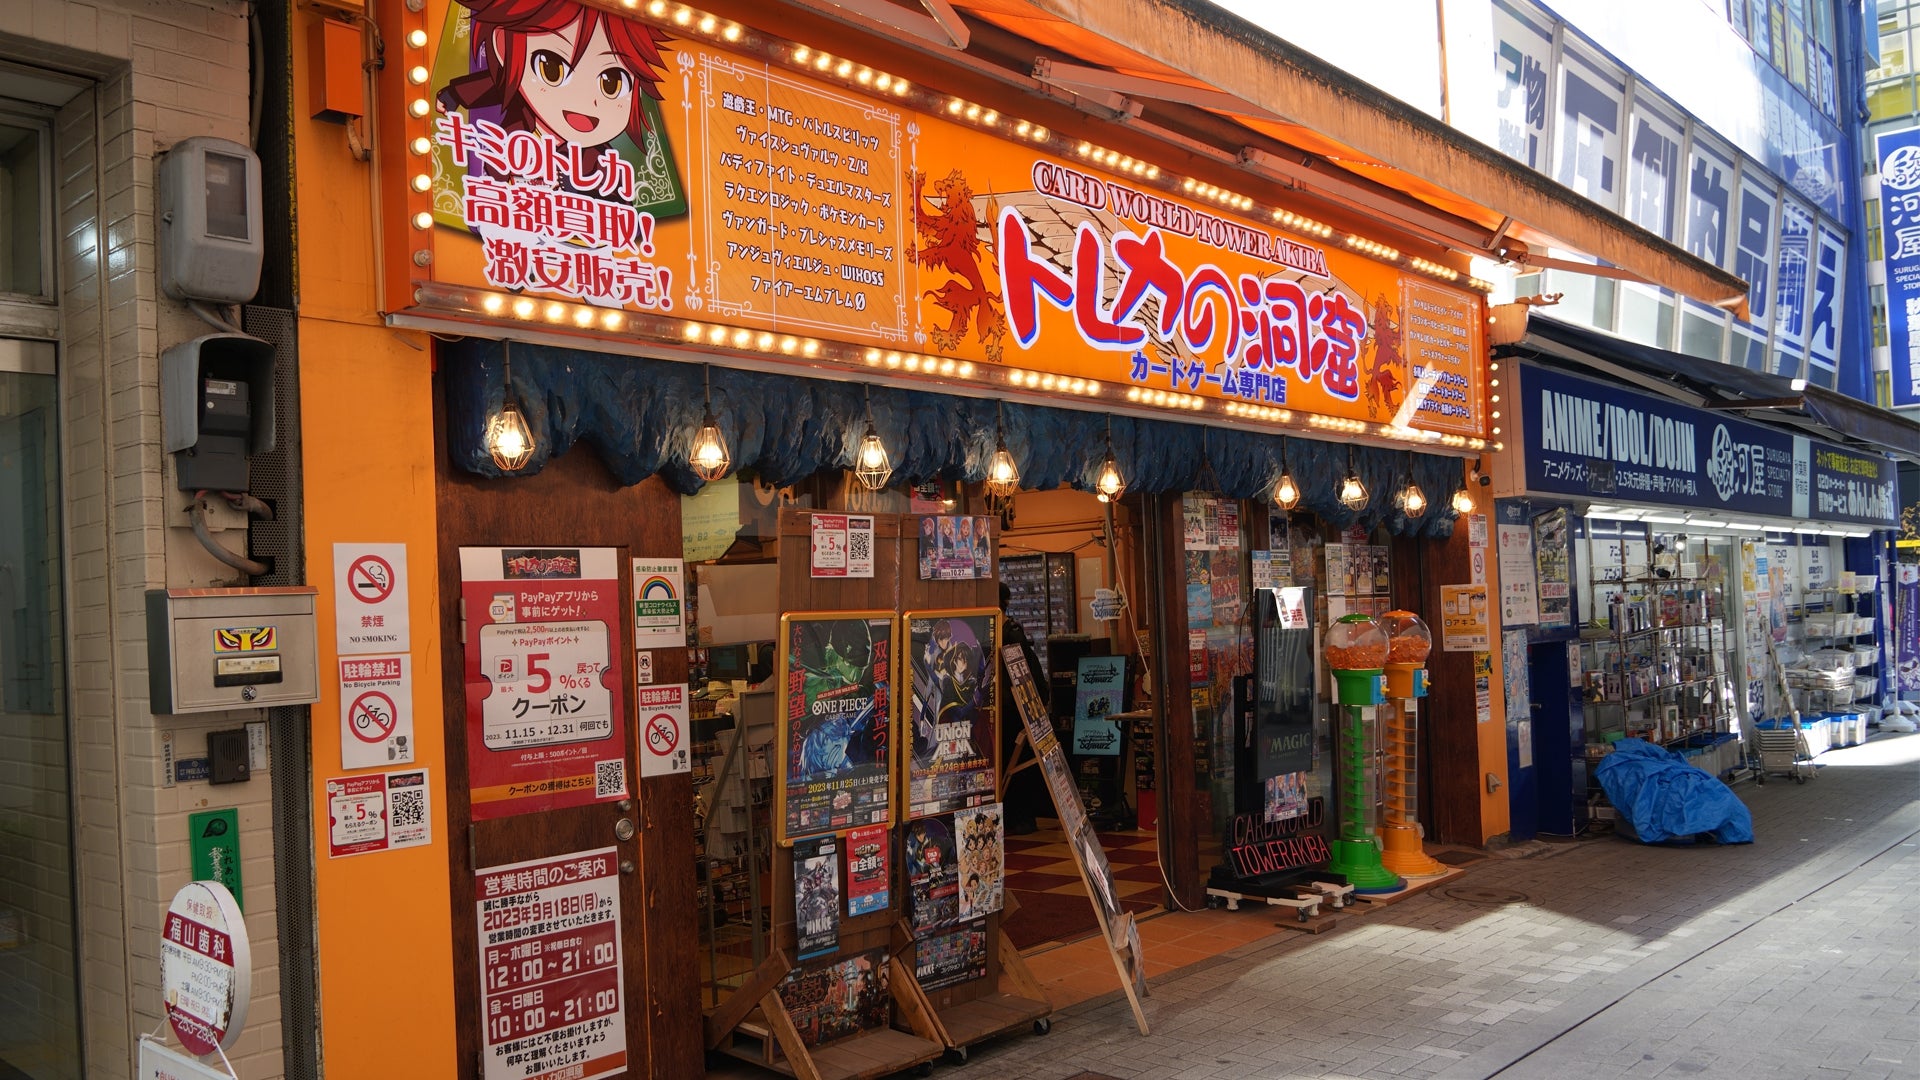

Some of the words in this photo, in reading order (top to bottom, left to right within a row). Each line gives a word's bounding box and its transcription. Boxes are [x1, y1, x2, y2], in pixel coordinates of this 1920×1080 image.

[722, 91, 879, 151] 遊戯王・MTG・バトルスピリッツ
[436, 114, 633, 200] キミのトレカ
[720, 151, 891, 208] バディファイト・デュエルマスターズ
[724, 181, 885, 234] ラクエンロジック・ポケモンカード
[466, 179, 655, 257] 高額買取!
[1032, 161, 1107, 210] CARD
[1107, 183, 1197, 237] WORLD
[1197, 214, 1271, 259] TOWER
[1271, 236, 1329, 278] AKIBA
[722, 210, 893, 262] ヴァンガード・プレシャスメモリーズ
[485, 237, 674, 309] 激安販売!
[1000, 206, 1366, 402] トレカの洞窟
[1132, 352, 1287, 404] カードゲーム専門店
[1707, 423, 1767, 501] 駿河屋
[1768, 483, 1783, 498] STORE
[829, 537, 835, 550] 5
[521, 590, 599, 605] PayPayアプリから
[360, 615, 384, 628] 禁煙
[521, 605, 581, 618] 事前にゲット!
[350, 636, 361, 644] NO
[363, 634, 398, 643] SMOKING
[519, 636, 573, 647] PayPayポイント
[344, 659, 399, 679] 駐輪禁止
[527, 653, 552, 694] 5
[576, 662, 600, 674] 戻って
[354, 680, 376, 690] Bicycle
[377, 678, 401, 688] Parking
[559, 674, 577, 690] %
[577, 676, 591, 689] くる
[512, 693, 586, 719] クーポン
[642, 689, 681, 703] 駐輪禁止
[812, 700, 837, 716] ONE
[839, 697, 868, 712] PIECE
[505, 727, 536, 739] 11.15
[547, 724, 574, 736] 12.31
[580, 720, 609, 731] 何回でも
[935, 724, 972, 742] UNION
[1271, 732, 1311, 752] MAGIC
[509, 776, 595, 796] クーポンの獲得はこちら!
[356, 804, 366, 820] 5
[368, 811, 377, 819] %
[485, 857, 607, 896] 営業時間のご案内
[483, 892, 540, 911] 誠に勝手ながら
[488, 909, 615, 944] 営業時間の変更させていただきます。
[171, 916, 225, 960] 福山歯科
[495, 1018, 614, 1057] お客様にはご不便お掛けしますが、
[506, 1032, 606, 1068] 何卒ご理解くださいますよう
[525, 1050, 590, 1075] お願いいたします。
